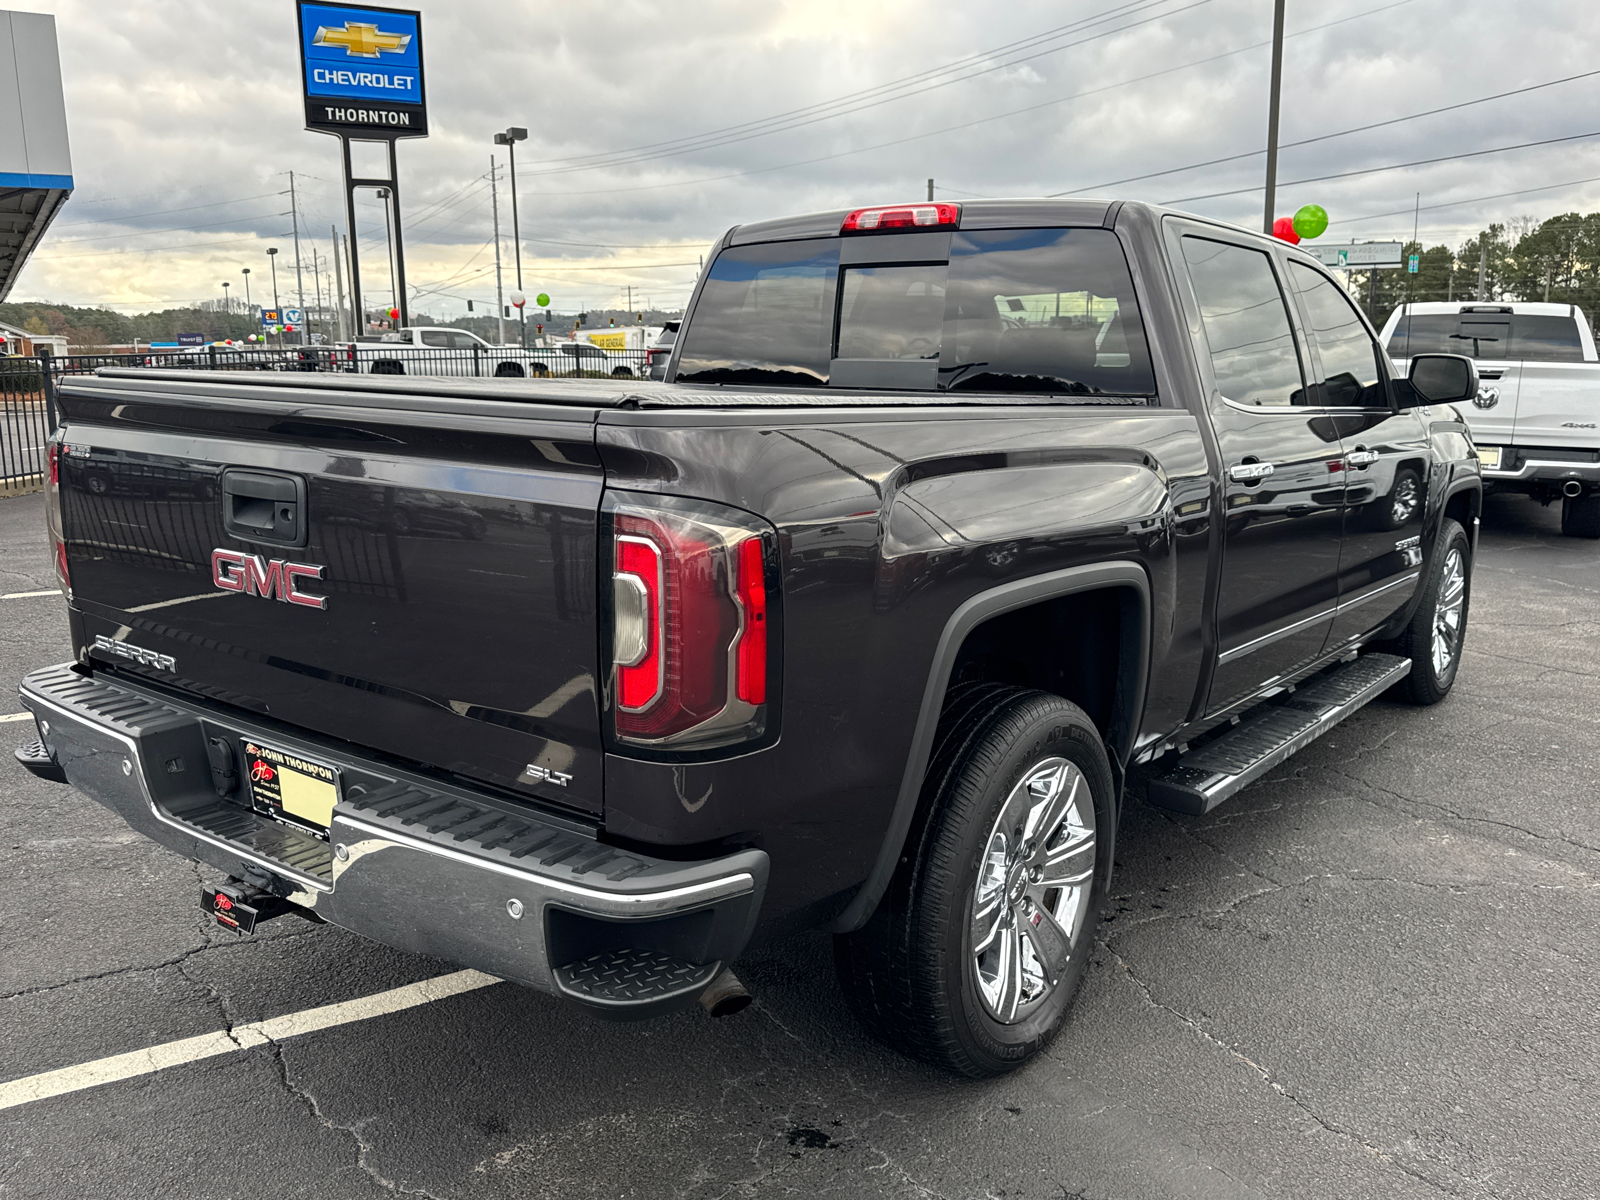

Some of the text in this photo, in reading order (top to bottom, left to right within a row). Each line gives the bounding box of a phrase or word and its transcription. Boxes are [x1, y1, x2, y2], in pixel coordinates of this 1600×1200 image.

[313, 69, 414, 89] CHEVROLET
[325, 107, 409, 125] THORNTON
[606, 337, 624, 347] GENERAL
[211, 548, 329, 611] GMC
[95, 634, 177, 674] SIERRA
[261, 748, 284, 763] JOHN
[526, 764, 574, 787] SLT
